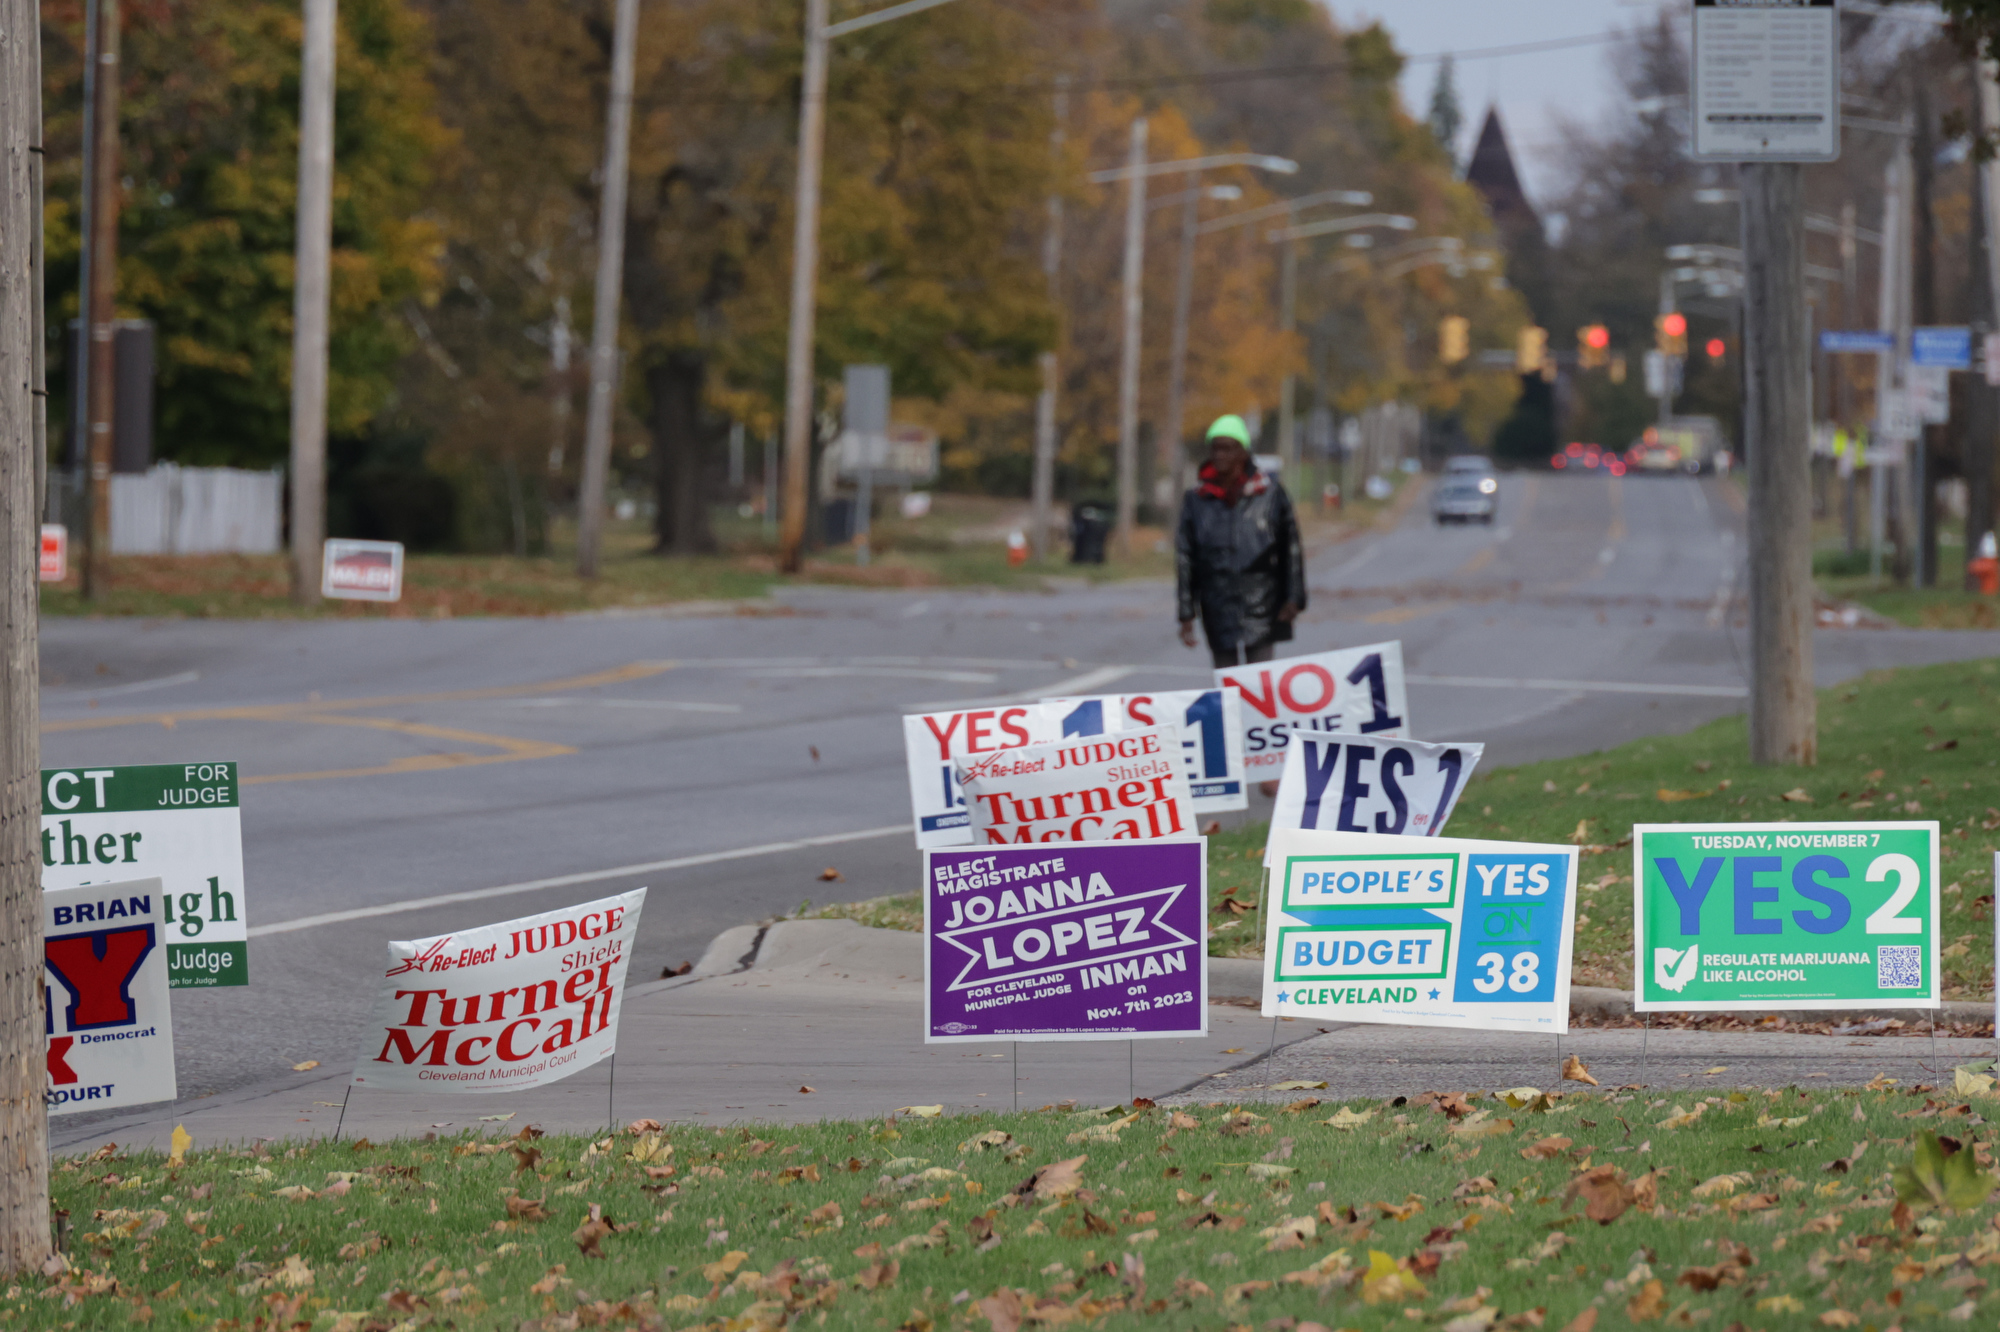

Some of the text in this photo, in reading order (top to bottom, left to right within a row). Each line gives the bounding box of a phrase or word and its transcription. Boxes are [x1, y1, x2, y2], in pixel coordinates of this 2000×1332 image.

[1222, 652, 1403, 735] NO 1
[922, 708, 1030, 761] YES
[1185, 690, 1228, 779] 1
[990, 757, 1046, 779] Re-Elect
[1053, 734, 1162, 770] JUDGE
[1107, 759, 1171, 783] Shiela
[47, 764, 230, 811] CT FOR
[158, 786, 231, 806] JUDGE
[976, 773, 1174, 826] Turner
[1300, 739, 1415, 836] YES
[1691, 833, 1881, 850] TUESDAY, NOVEMBER 7
[934, 855, 997, 882] ELECT
[937, 857, 1067, 897] MAGISTRATE
[1301, 869, 1445, 895] PEOPLE'S
[1474, 862, 1551, 897] YES
[53, 894, 151, 926] BRIAN
[944, 871, 1116, 929] JOANNA
[1653, 853, 1923, 936] YES 2
[982, 906, 1151, 971] LOPEZ
[1483, 907, 1533, 938] ON
[429, 906, 625, 973] Re-Elect JUDGE
[1293, 939, 1433, 967] BUDGET
[170, 947, 233, 974] Judge
[561, 939, 622, 974] Shiela
[1079, 949, 1188, 991] INMAN
[1703, 952, 1871, 967] REGULATE MARIJUANA
[181, 977, 193, 985] for
[194, 976, 218, 986] Judge
[966, 972, 1066, 1000] FOR CLEVELAND
[1472, 951, 1540, 995] 38
[1703, 969, 1807, 983] LIKE ALCOHOL
[394, 954, 622, 1027] Turner
[964, 983, 1073, 1013] MUNICIPAL JUDGE
[1086, 989, 1194, 1021] Nov. 7th 2023
[1126, 984, 1148, 998] on
[1293, 986, 1418, 1006] CLEVELAND
[80, 1026, 157, 1045] Democrat
[372, 985, 615, 1066] McCall
[418, 1070, 486, 1082] Cleveland
[489, 1059, 547, 1080] Municipal
[549, 1050, 578, 1069] Court
[47, 1083, 116, 1106] OURT
